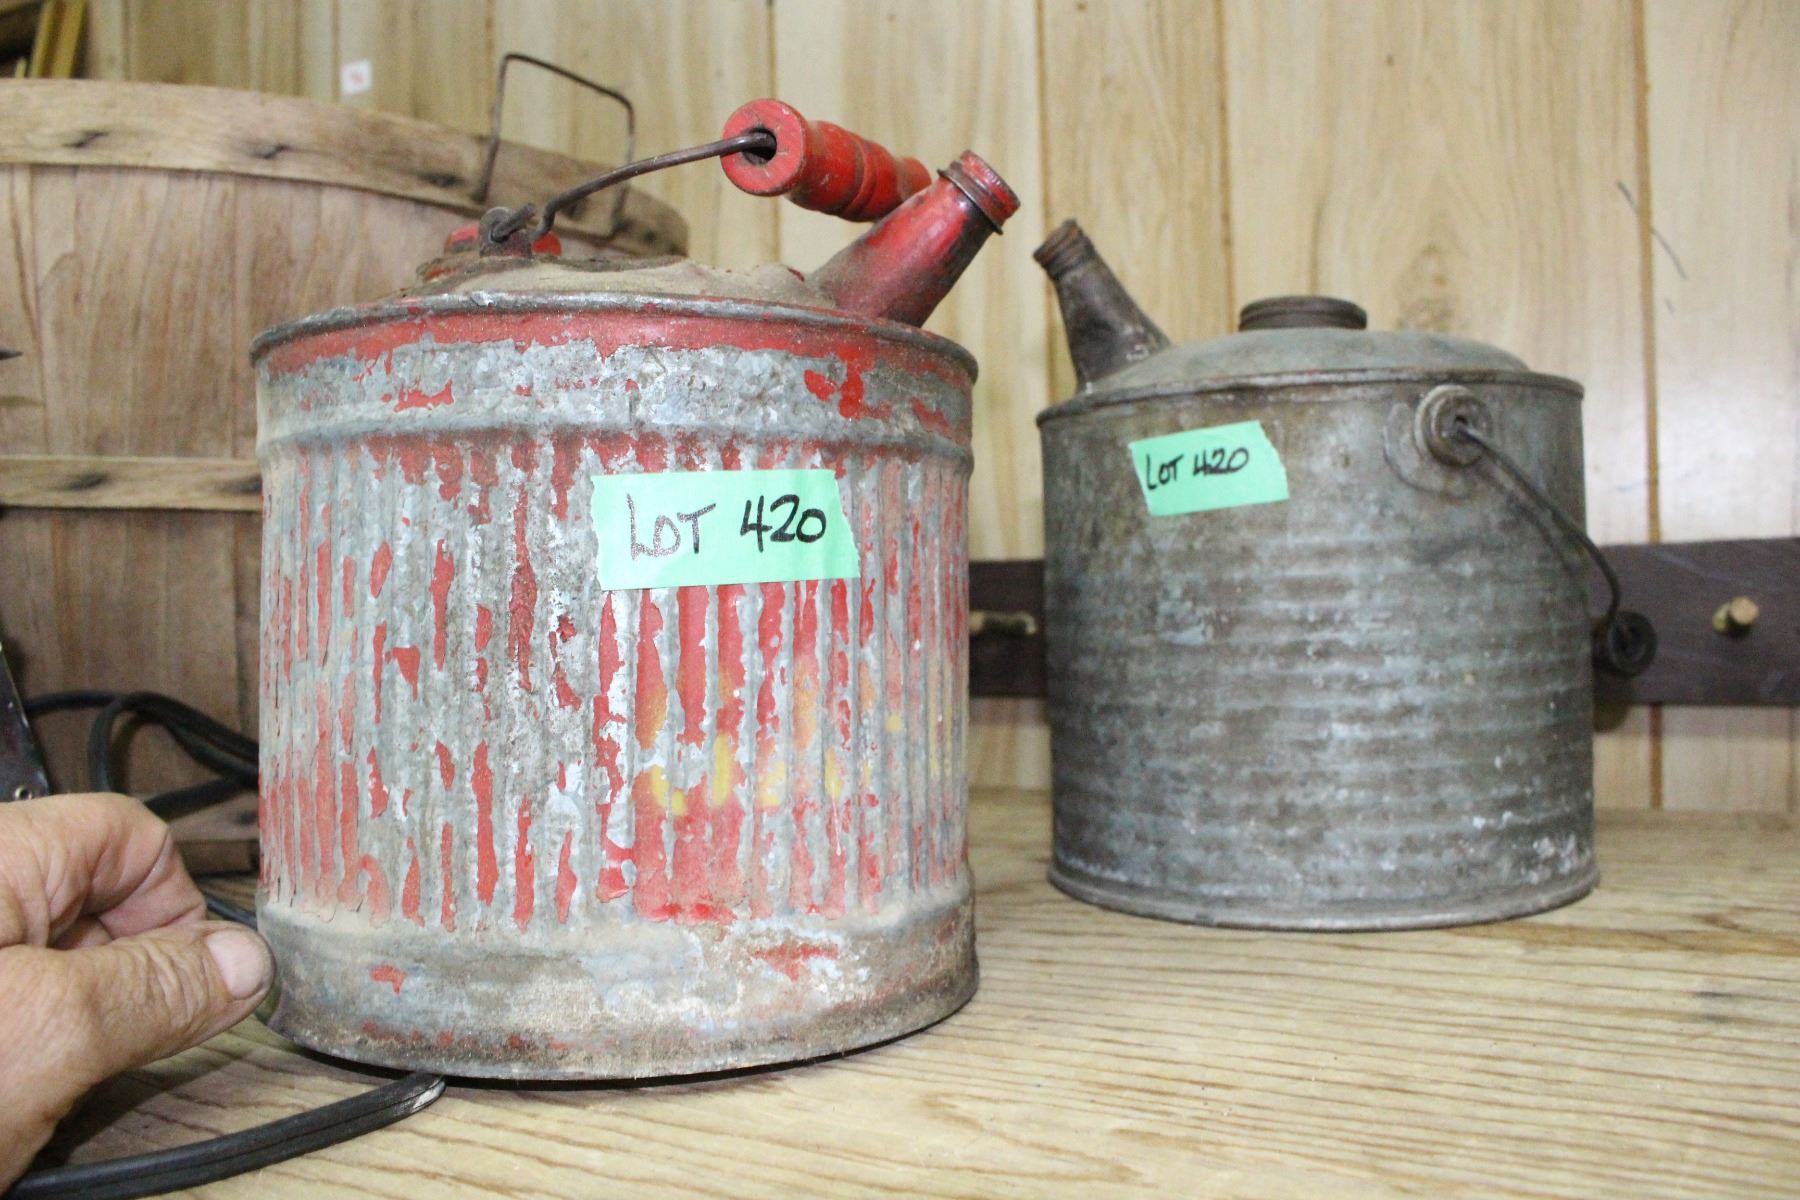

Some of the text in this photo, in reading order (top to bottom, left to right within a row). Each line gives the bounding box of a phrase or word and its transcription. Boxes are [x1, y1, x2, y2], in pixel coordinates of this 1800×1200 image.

[1146, 447, 1249, 490] LOT 420
[626, 493, 827, 560] LOT 420
